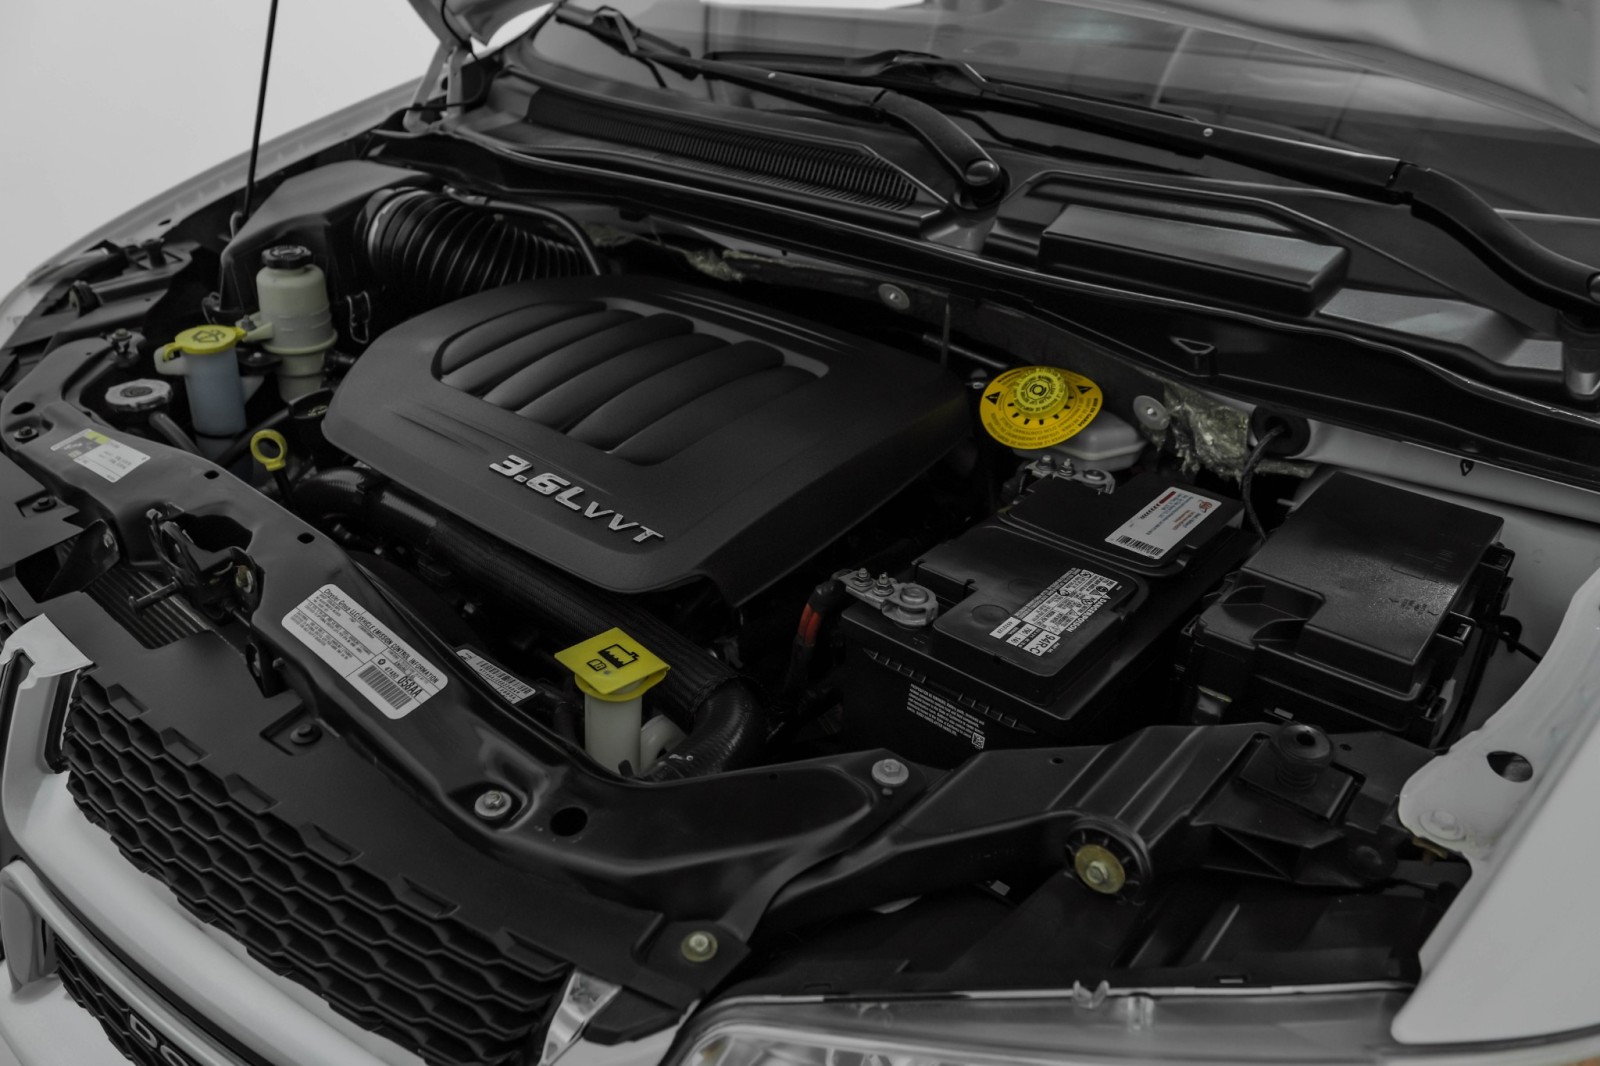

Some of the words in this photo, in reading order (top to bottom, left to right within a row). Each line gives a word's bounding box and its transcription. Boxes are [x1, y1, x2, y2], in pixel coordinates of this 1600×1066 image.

[349, 608, 360, 618] LLC
[357, 615, 375, 630] VEHICLE
[373, 627, 393, 645] EMISSION
[391, 642, 411, 661] CONTROL
[409, 658, 440, 683] INFORMATION
[1030, 634, 1056, 654] 94R-C
[397, 675, 423, 698] 058AA
